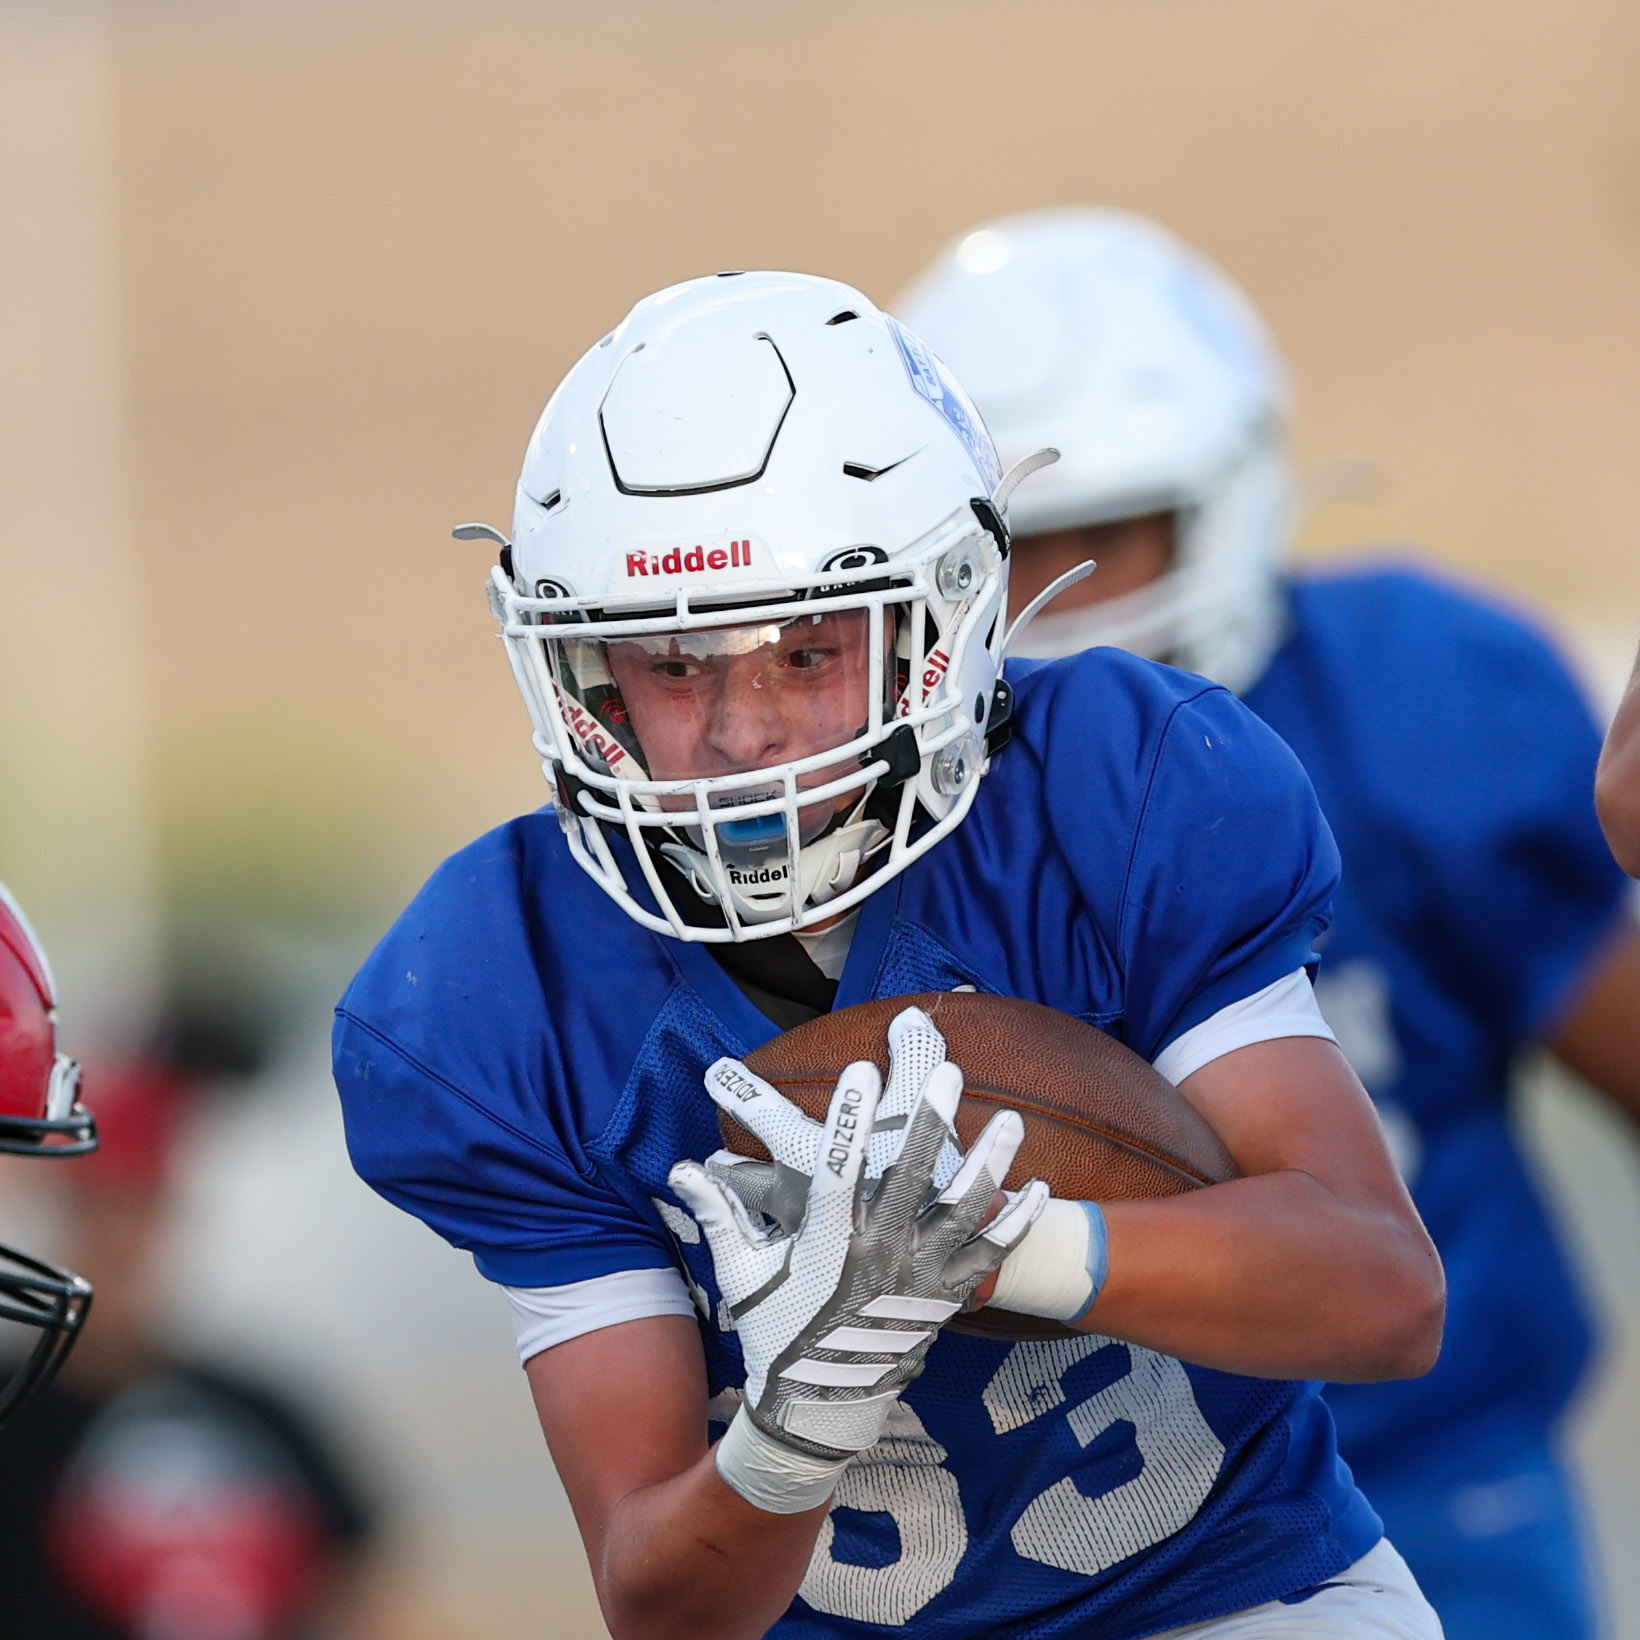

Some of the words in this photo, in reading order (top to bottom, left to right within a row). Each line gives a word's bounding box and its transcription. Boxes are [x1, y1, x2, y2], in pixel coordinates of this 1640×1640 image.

[625, 539, 752, 578] Riddell
[728, 864, 790, 885] Riddel
[826, 1087, 863, 1179] ADIZERO
